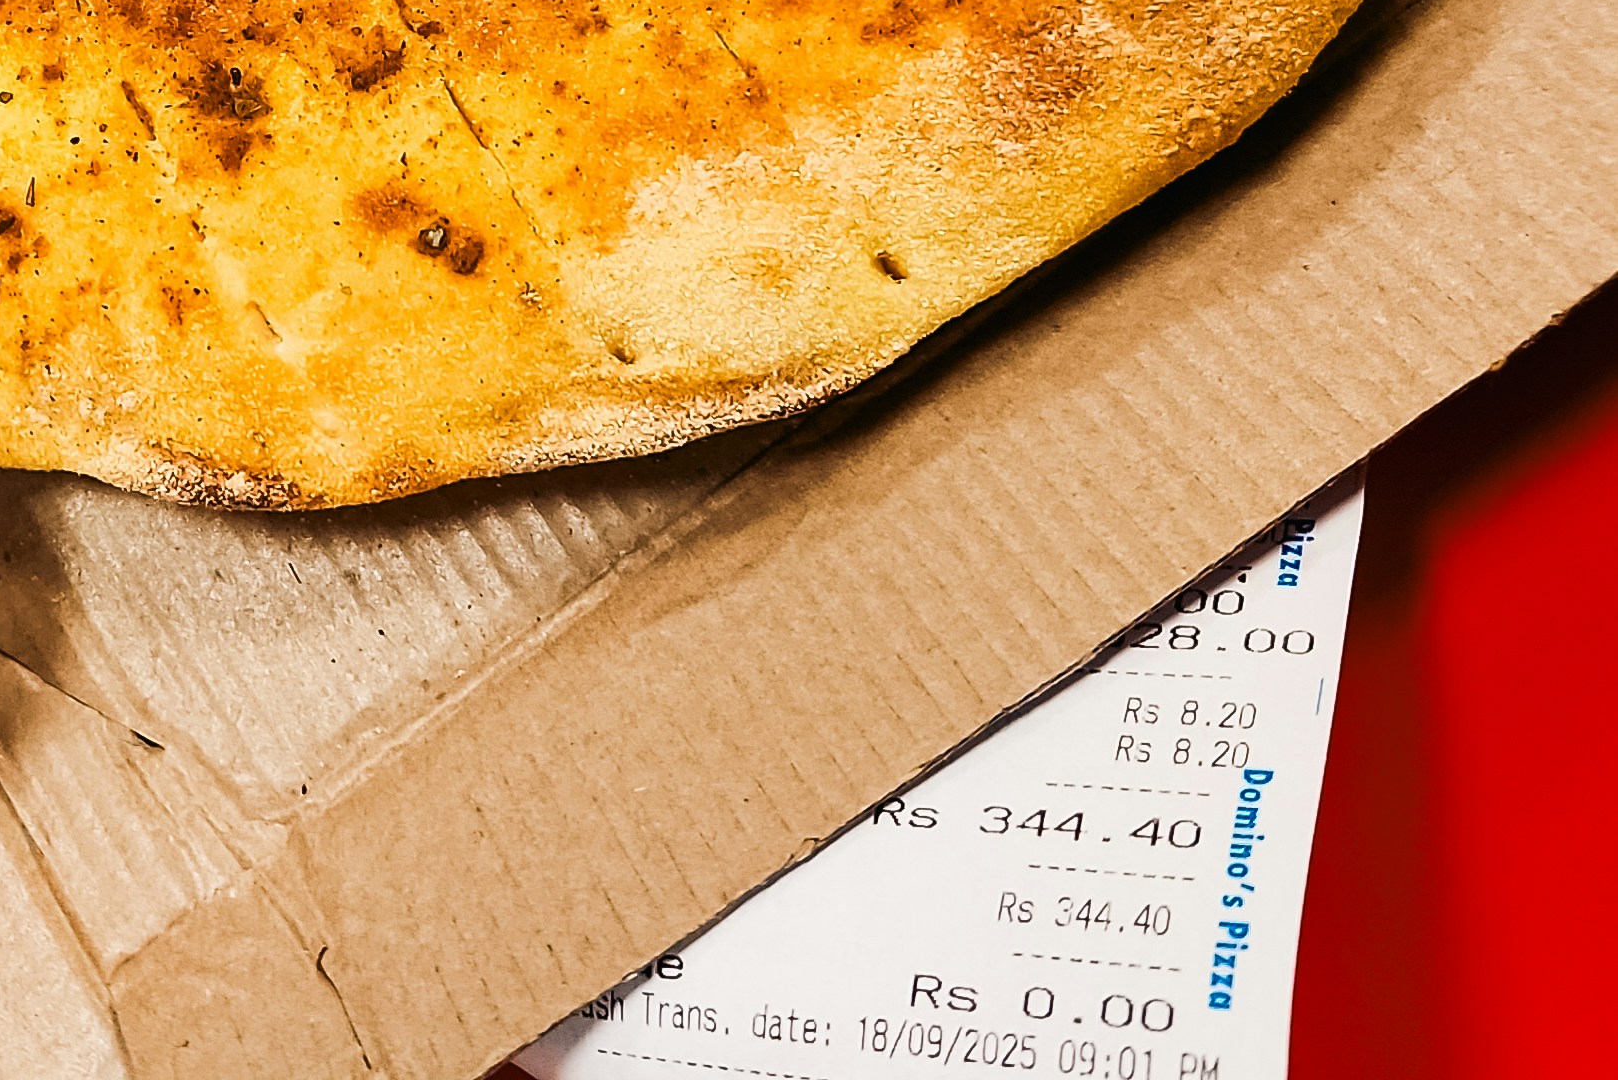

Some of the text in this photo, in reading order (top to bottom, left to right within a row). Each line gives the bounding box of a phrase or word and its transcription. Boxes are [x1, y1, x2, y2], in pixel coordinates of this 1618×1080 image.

[1277, 519, 1315, 586] Pizza
[1123, 697, 1257, 729] Rs 8.20
[1115, 735, 1250, 768] Rs 8.20
[873, 796, 1202, 849] Rs 344.40
[998, 892, 1172, 936] Rs 344.40
[1208, 768, 1274, 1011] Domino's Pizza
[910, 974, 1175, 1032] Rs 0.00
[641, 991, 730, 1036] Trans.
[752, 1003, 832, 1047] date:
[858, 1016, 1037, 1070] 18/09/2025
[1059, 1039, 1152, 1080] 09:01
[1180, 1051, 1220, 1080] PM
